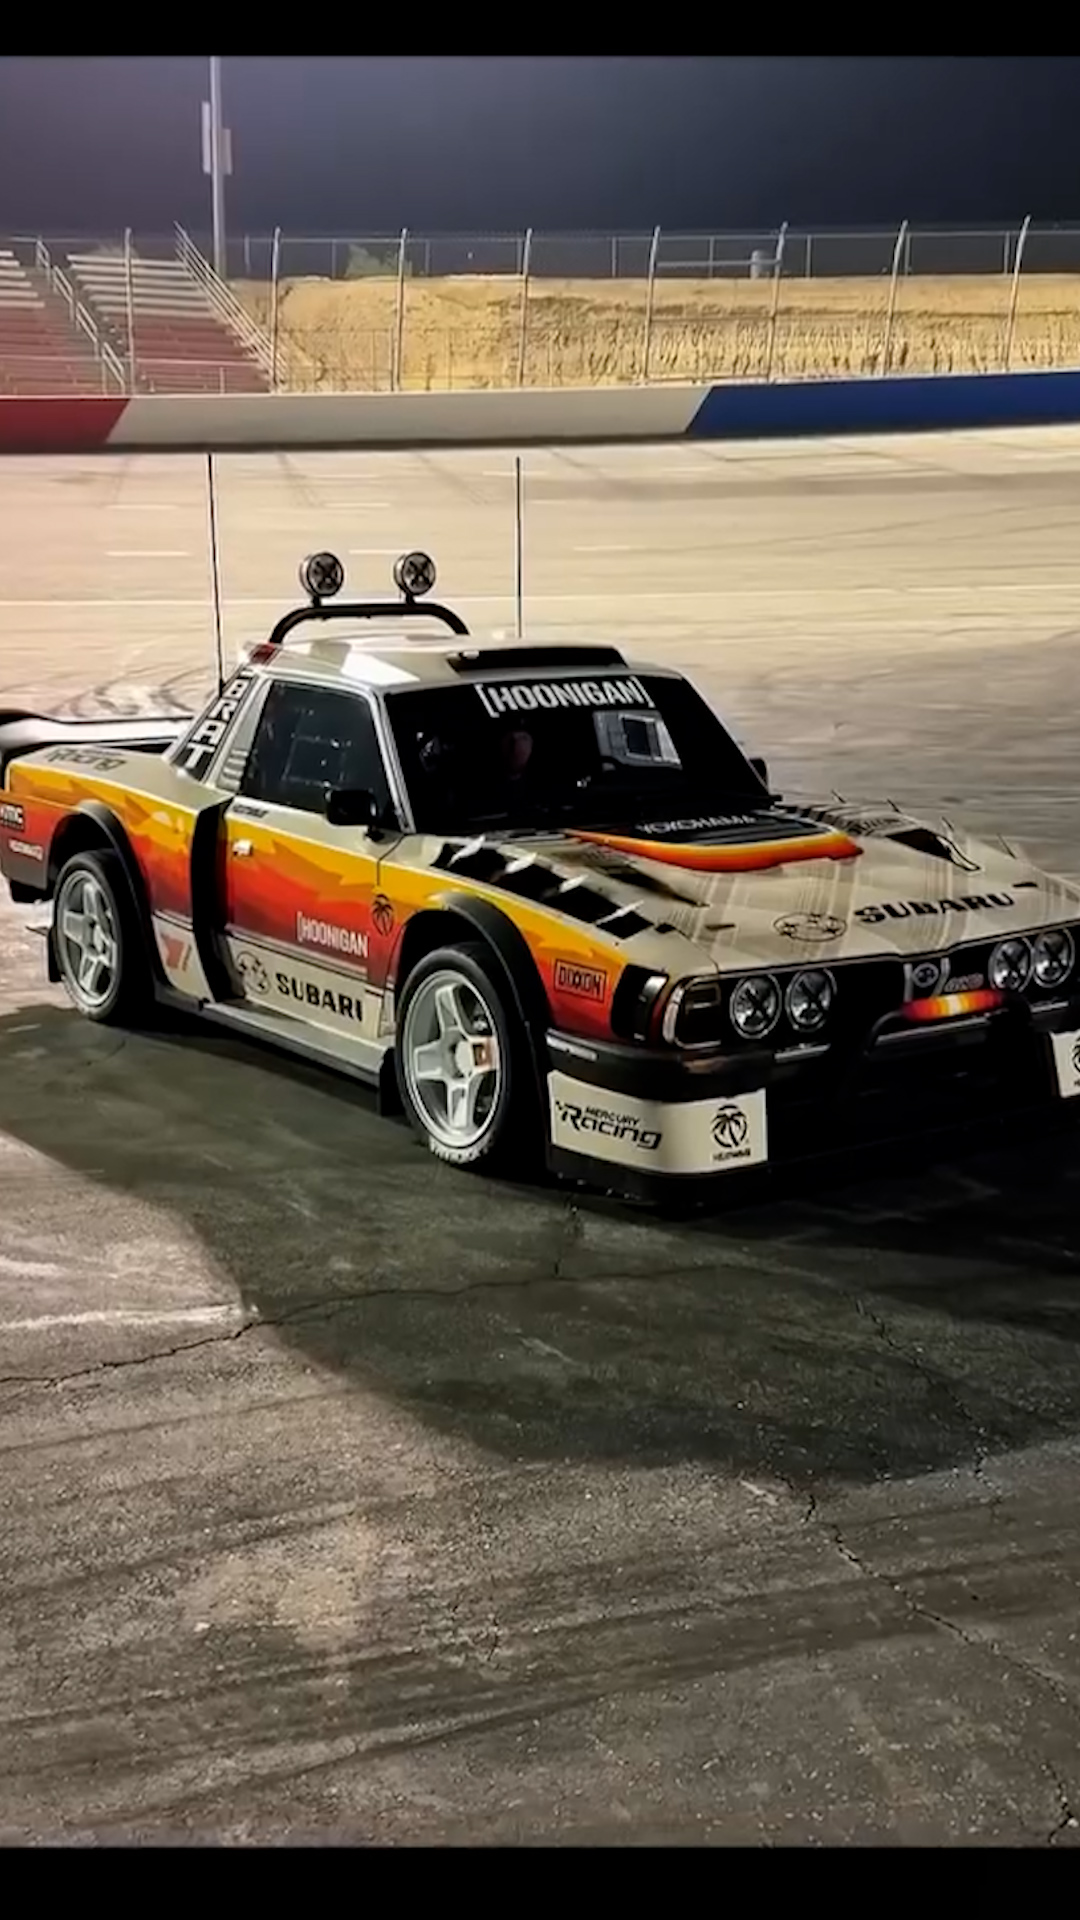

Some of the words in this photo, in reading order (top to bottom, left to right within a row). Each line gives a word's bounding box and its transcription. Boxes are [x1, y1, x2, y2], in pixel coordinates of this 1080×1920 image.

[474, 675, 656, 718] [HOONIGAN]
[184, 678, 250, 769] BRAT
[854, 892, 1015, 924] SUBARU
[554, 1099, 662, 1150] Racing
[584, 1105, 641, 1126] MERCURY
